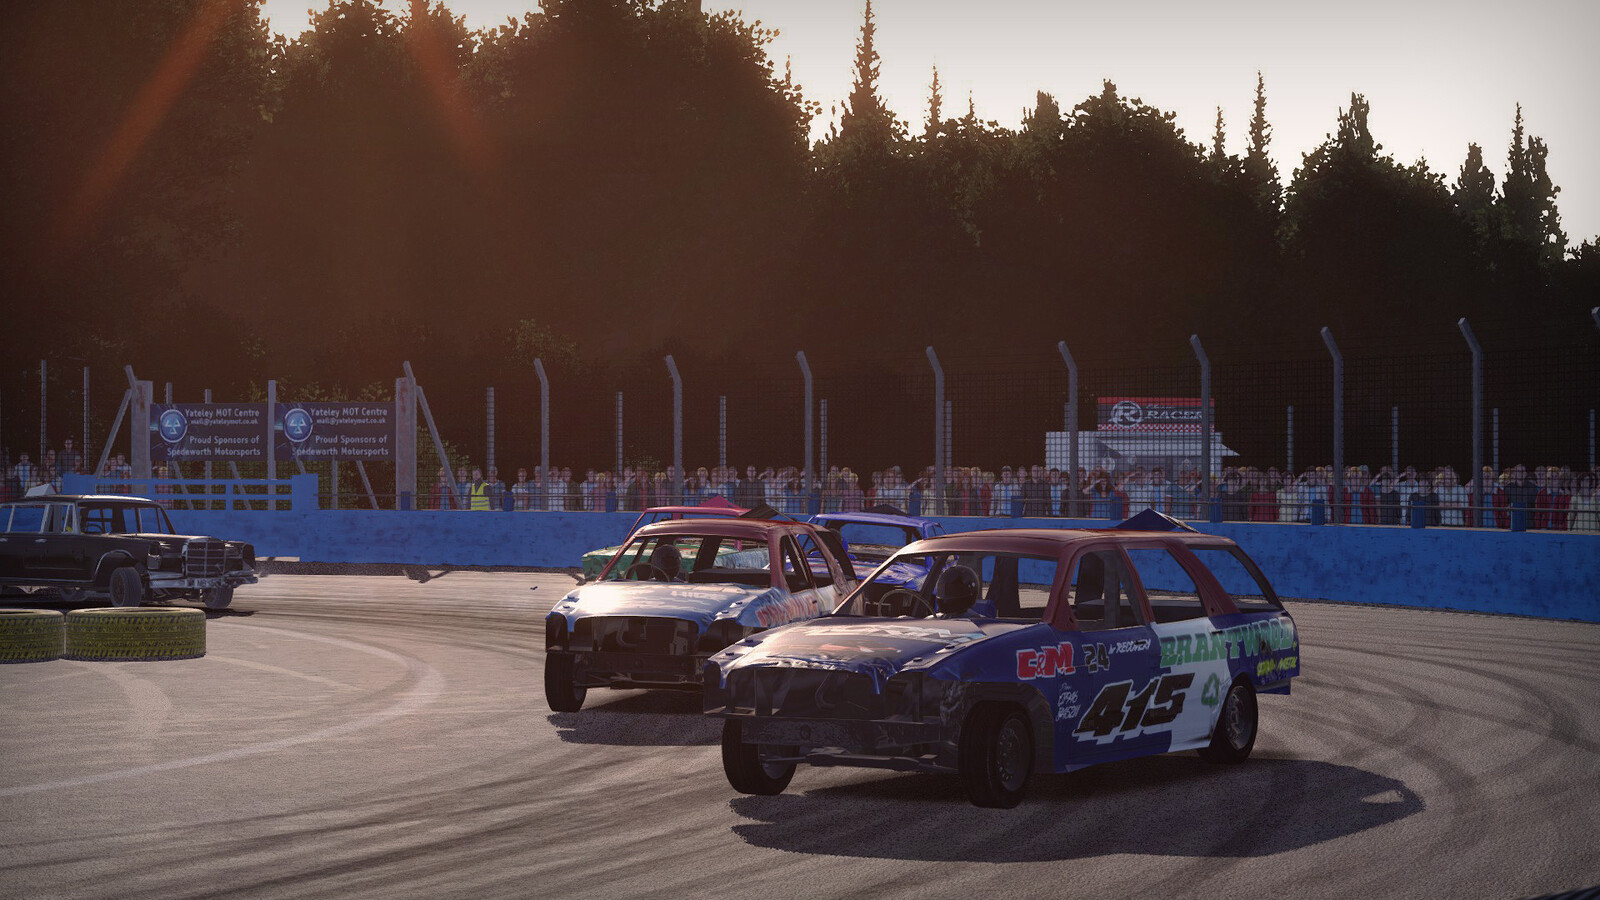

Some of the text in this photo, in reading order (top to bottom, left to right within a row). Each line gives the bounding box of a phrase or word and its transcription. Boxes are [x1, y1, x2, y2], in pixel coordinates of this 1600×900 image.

[184, 408, 260, 419] Yateley MOT Centre
[310, 407, 388, 418] Yateley MOT Centre
[189, 434, 260, 445] Proud Sponsors of
[315, 434, 388, 445] Proud Sponsors of
[167, 447, 261, 458] Spedeworth Motorsports
[292, 446, 389, 458] Spedeworth Motorsports
[1016, 642, 1076, 680] C&M
[1081, 642, 1111, 673] 24
[1072, 672, 1195, 745] 415
